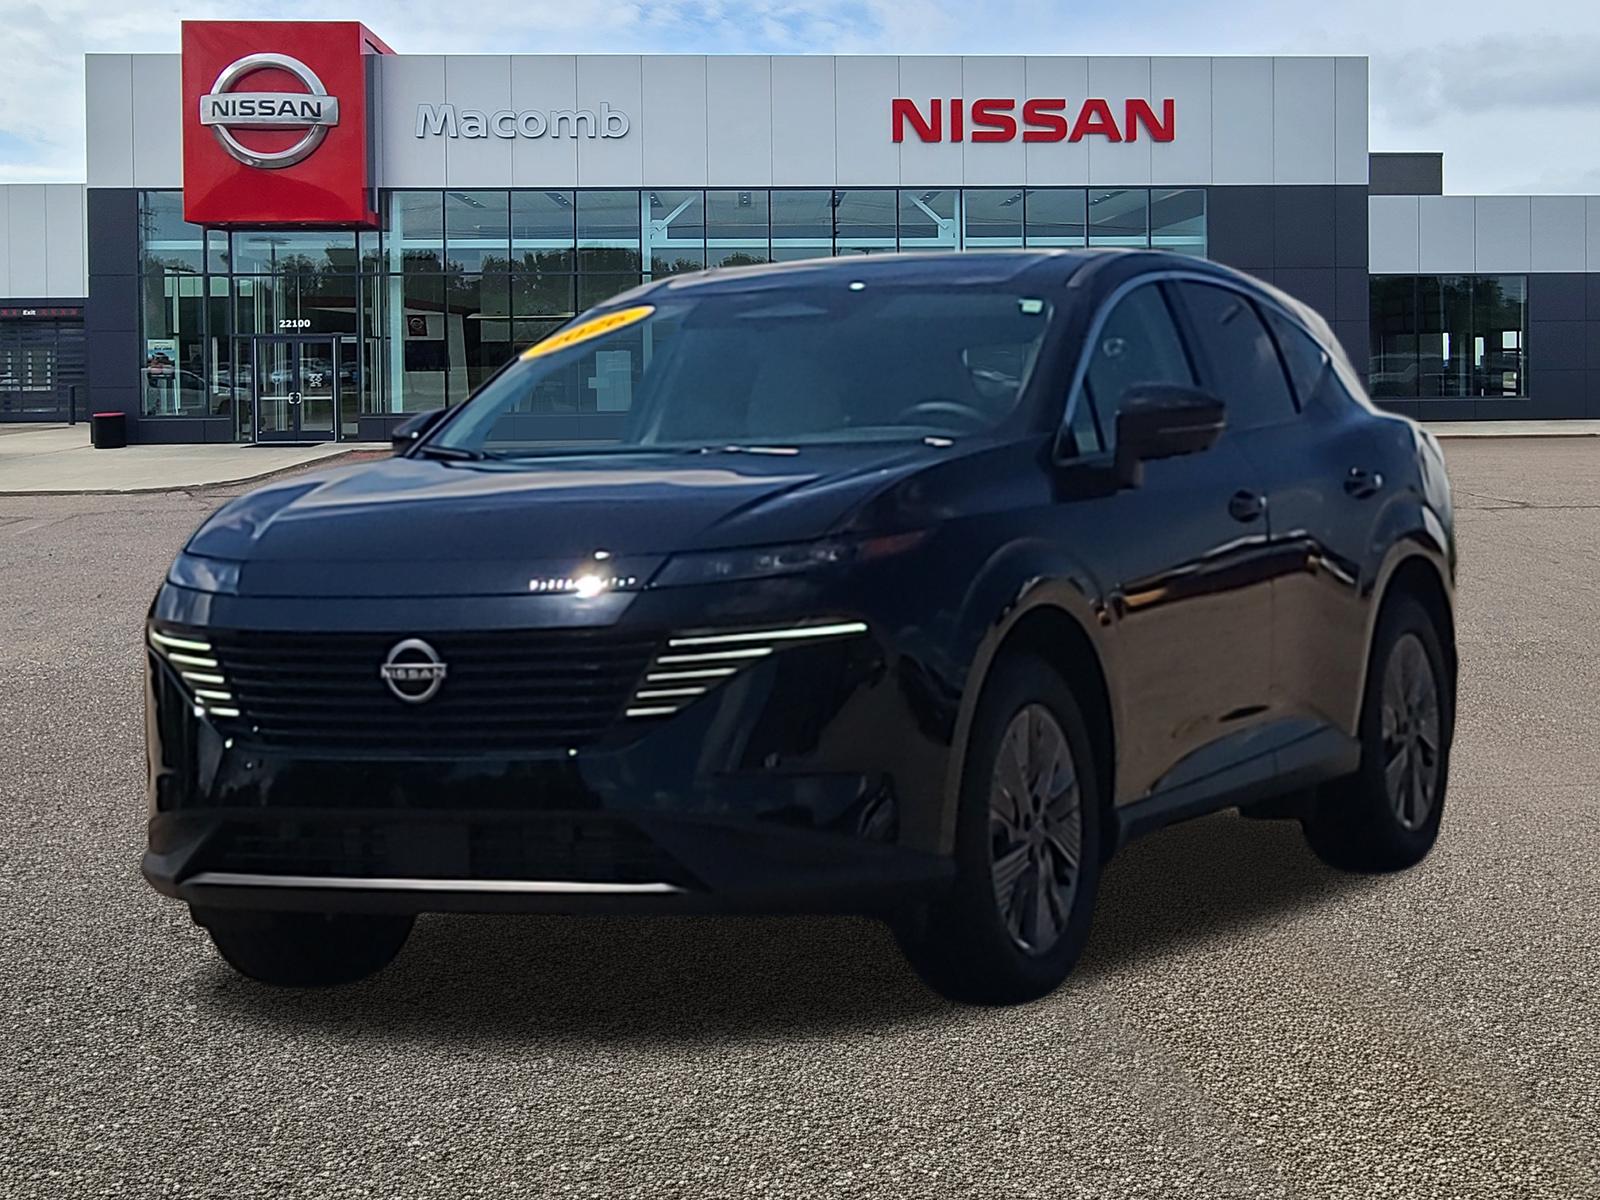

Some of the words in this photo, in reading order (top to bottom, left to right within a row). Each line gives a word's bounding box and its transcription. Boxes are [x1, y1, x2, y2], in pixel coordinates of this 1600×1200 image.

[212, 100, 322, 117] NISSAN
[415, 102, 630, 139] Macomb
[892, 99, 1177, 143] NISSAN
[279, 319, 311, 328] 22100
[381, 668, 447, 680] NISSAN
